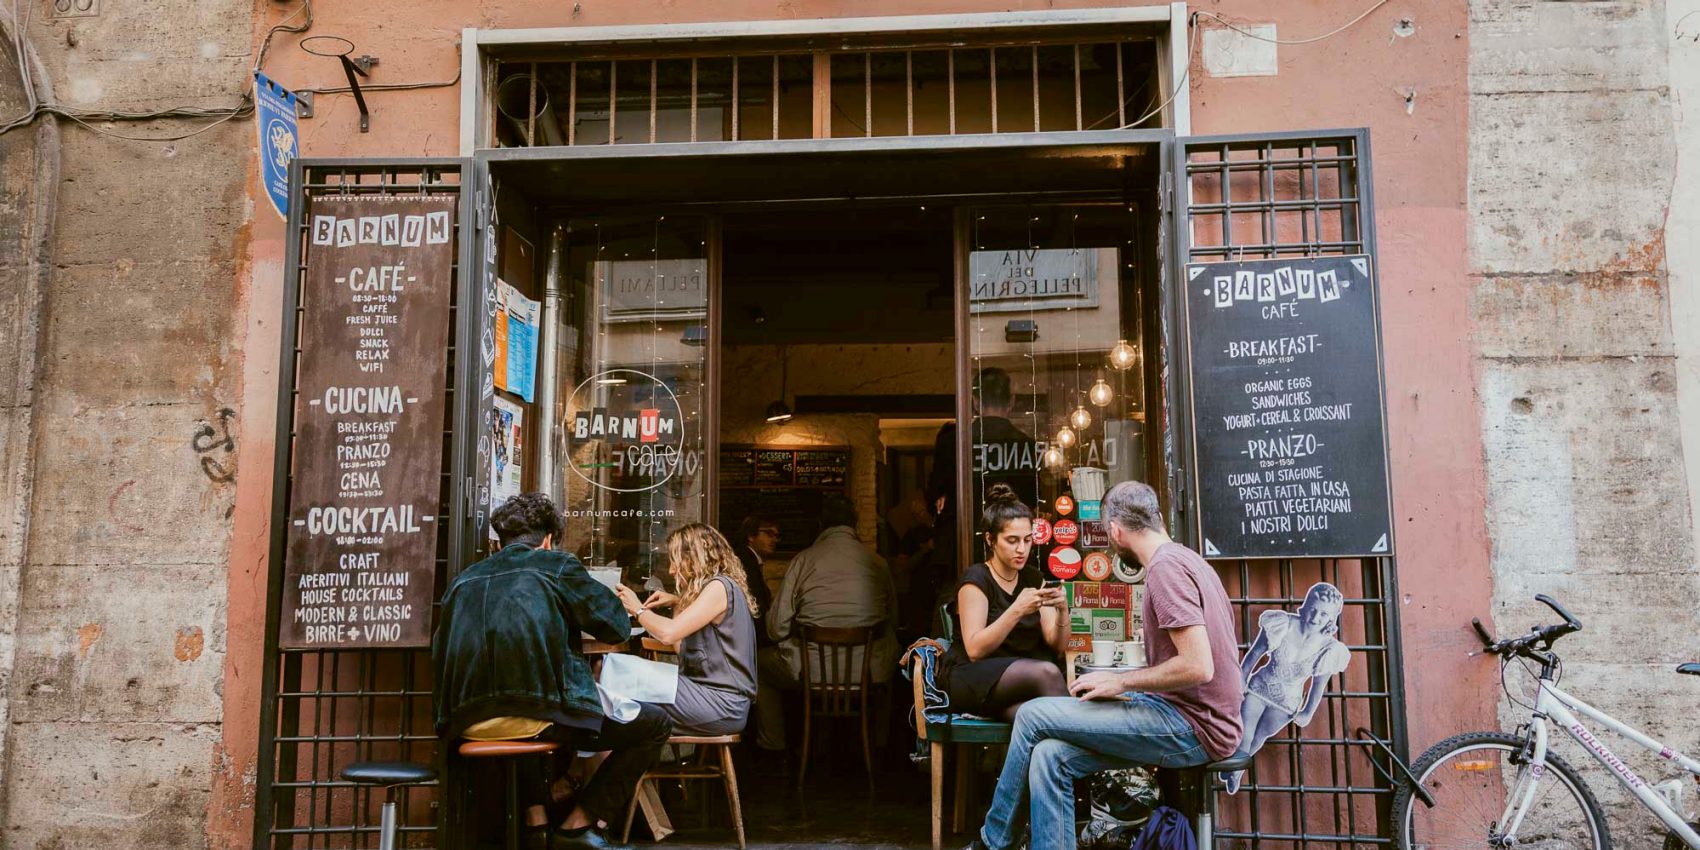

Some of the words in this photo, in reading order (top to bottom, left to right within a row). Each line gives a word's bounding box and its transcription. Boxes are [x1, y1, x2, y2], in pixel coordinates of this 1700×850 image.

[316, 214, 446, 244] BARNUM
[1216, 268, 1337, 304] BARNUM
[1261, 298, 1299, 320] CAFÉ
[346, 315, 371, 325] FRESH
[374, 315, 398, 325] JUICE
[359, 327, 384, 337] DOLCI
[359, 338, 389, 348] SNACK
[355, 349, 389, 360] RELAX
[359, 362, 383, 373] WIFI
[1244, 379, 1284, 394] ORGANIC
[1287, 376, 1312, 389] EGGS
[1251, 391, 1312, 410] SANDWICHES
[1293, 409, 1301, 423] &
[1304, 403, 1352, 421] CROISSANT
[337, 421, 397, 433] BREAKFAST
[574, 414, 674, 439] BARNUM
[337, 443, 391, 460] PRANZO
[761, 451, 790, 460] DESSERT
[340, 471, 381, 490] CENA
[1227, 472, 1261, 487] CUCINA
[1265, 471, 1274, 483] DI
[1278, 466, 1324, 482] STAGIONE
[1238, 486, 1271, 501] PASTA
[1275, 485, 1306, 499] FATTA
[1310, 482, 1320, 497] IN
[1323, 481, 1350, 498] CASA
[563, 508, 675, 518] barnumcafe.com
[1244, 500, 1279, 518] PIATTI
[1282, 497, 1352, 514] VEGETARIANI
[1241, 521, 1246, 535] I
[1251, 515, 1291, 535] NOSTRI
[1297, 514, 1328, 532] DOLCI
[1091, 535, 1109, 543] Roma
[339, 552, 380, 570] CRAFT
[1052, 566, 1077, 575] zomato
[298, 572, 350, 589] APERITIVI
[357, 571, 409, 587] ITALIANI
[301, 588, 337, 606] HOUSE
[341, 587, 404, 602] COCKTAILS
[1082, 596, 1099, 605] Roma
[1109, 597, 1126, 605] Roma
[294, 606, 345, 624] MODERN
[348, 605, 358, 622] &
[363, 604, 412, 621] CLASSIC
[305, 624, 345, 644] BIRRE
[363, 623, 401, 643] VINO
